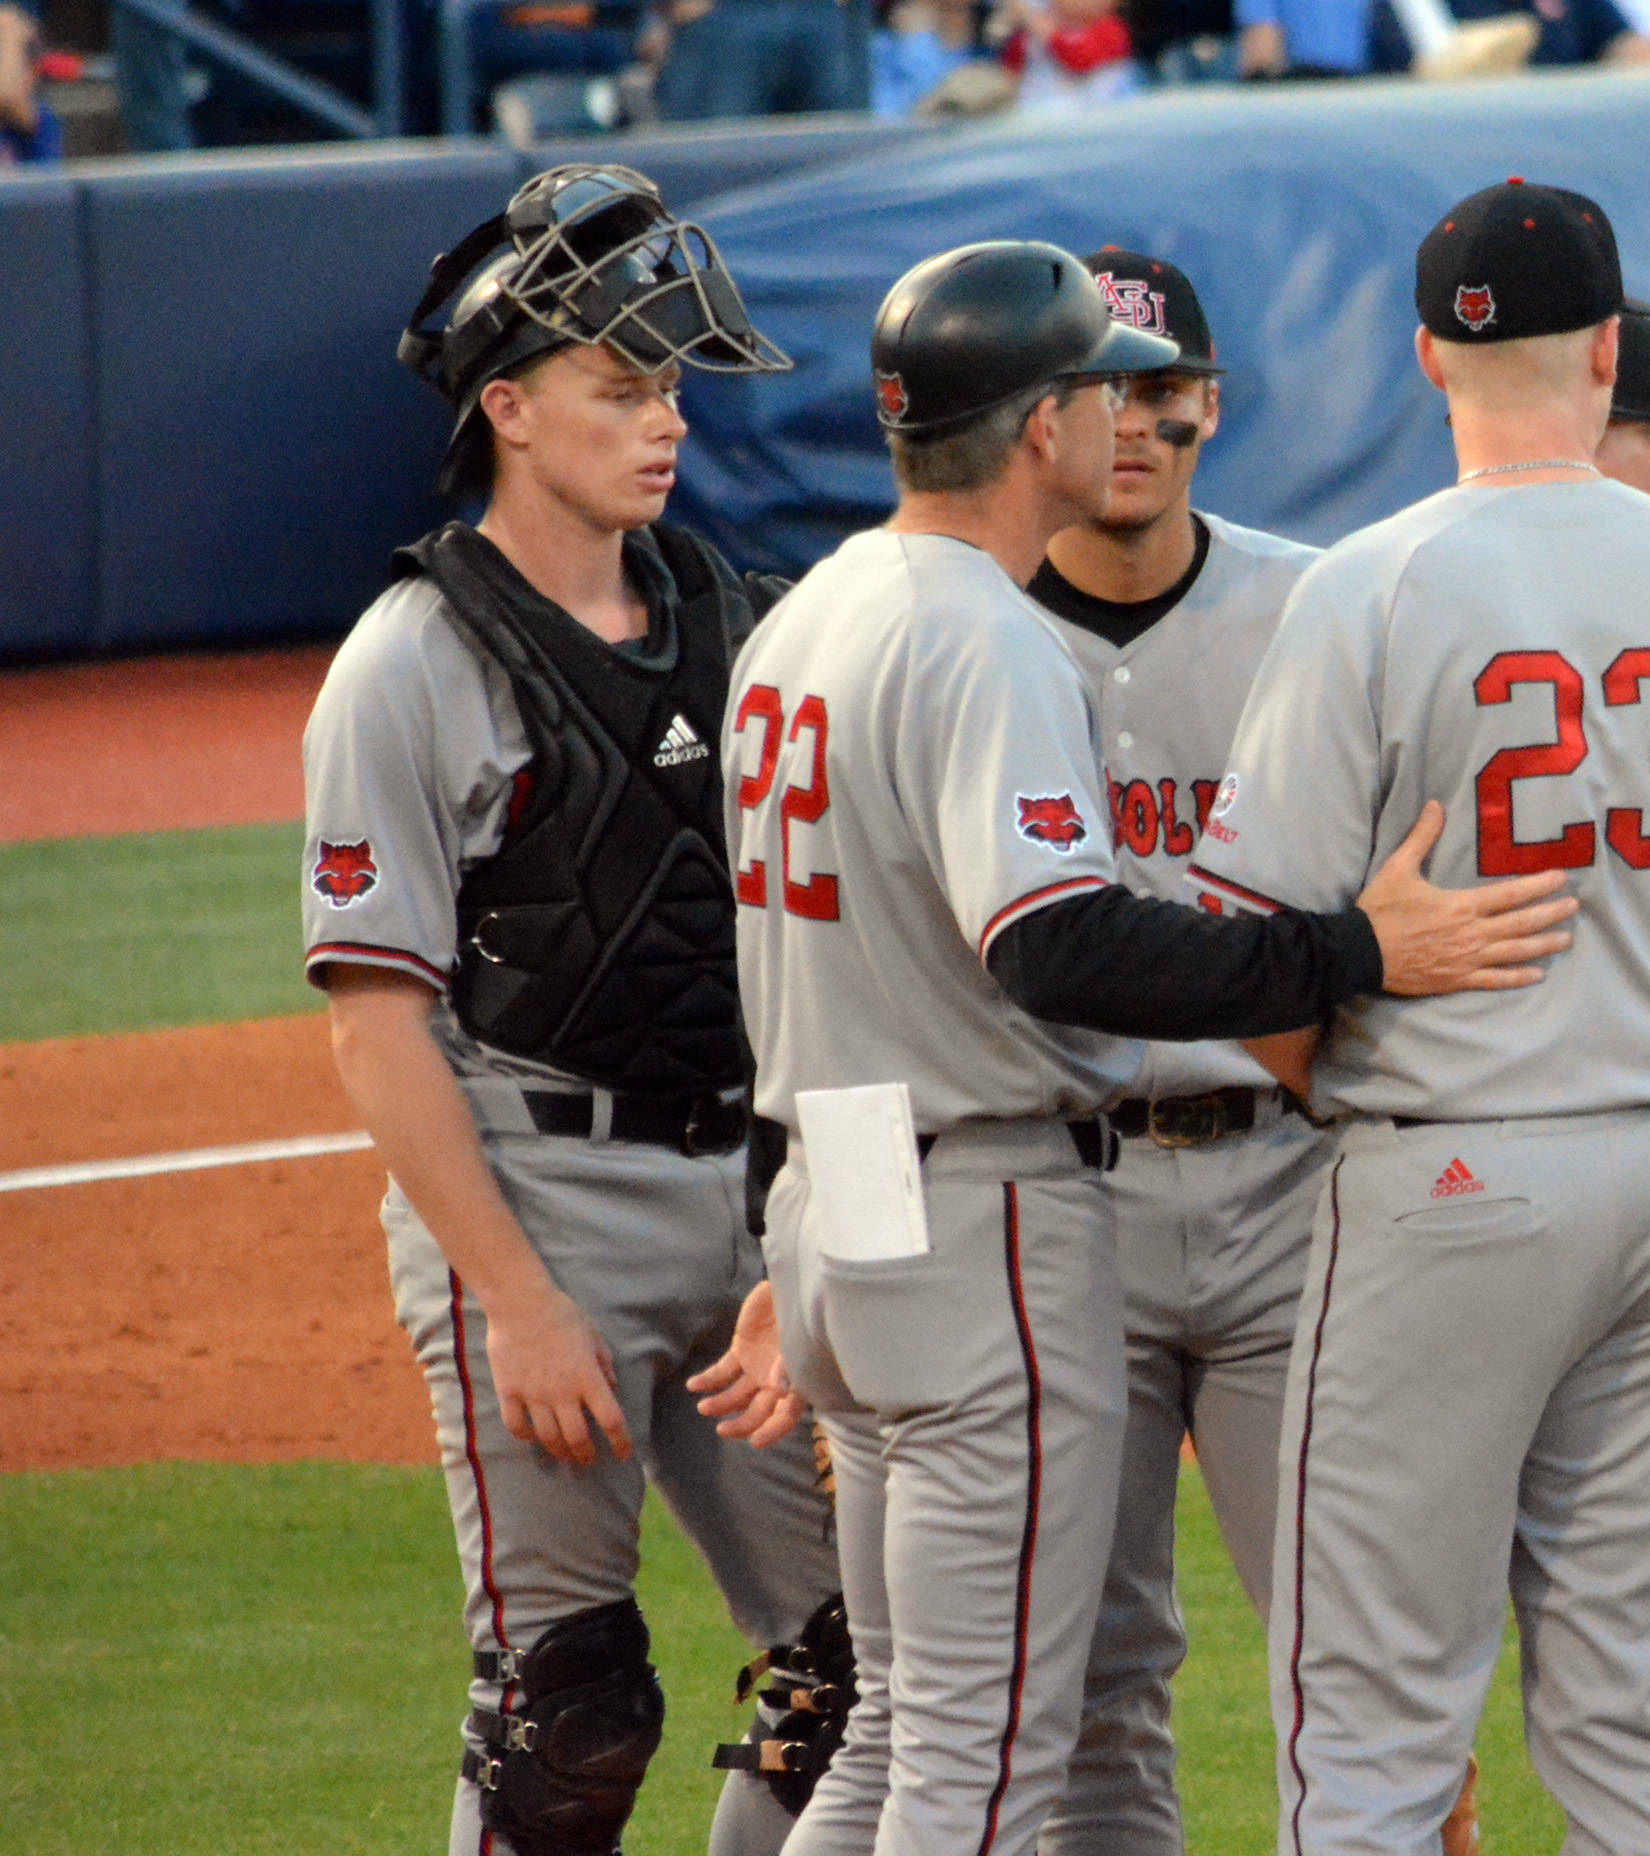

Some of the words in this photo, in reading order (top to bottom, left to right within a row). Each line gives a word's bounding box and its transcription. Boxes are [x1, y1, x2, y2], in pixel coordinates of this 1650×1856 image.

[653, 743, 710, 768] adidas
[734, 683, 841, 922] 22
[1430, 1180, 1485, 1199] adidas
